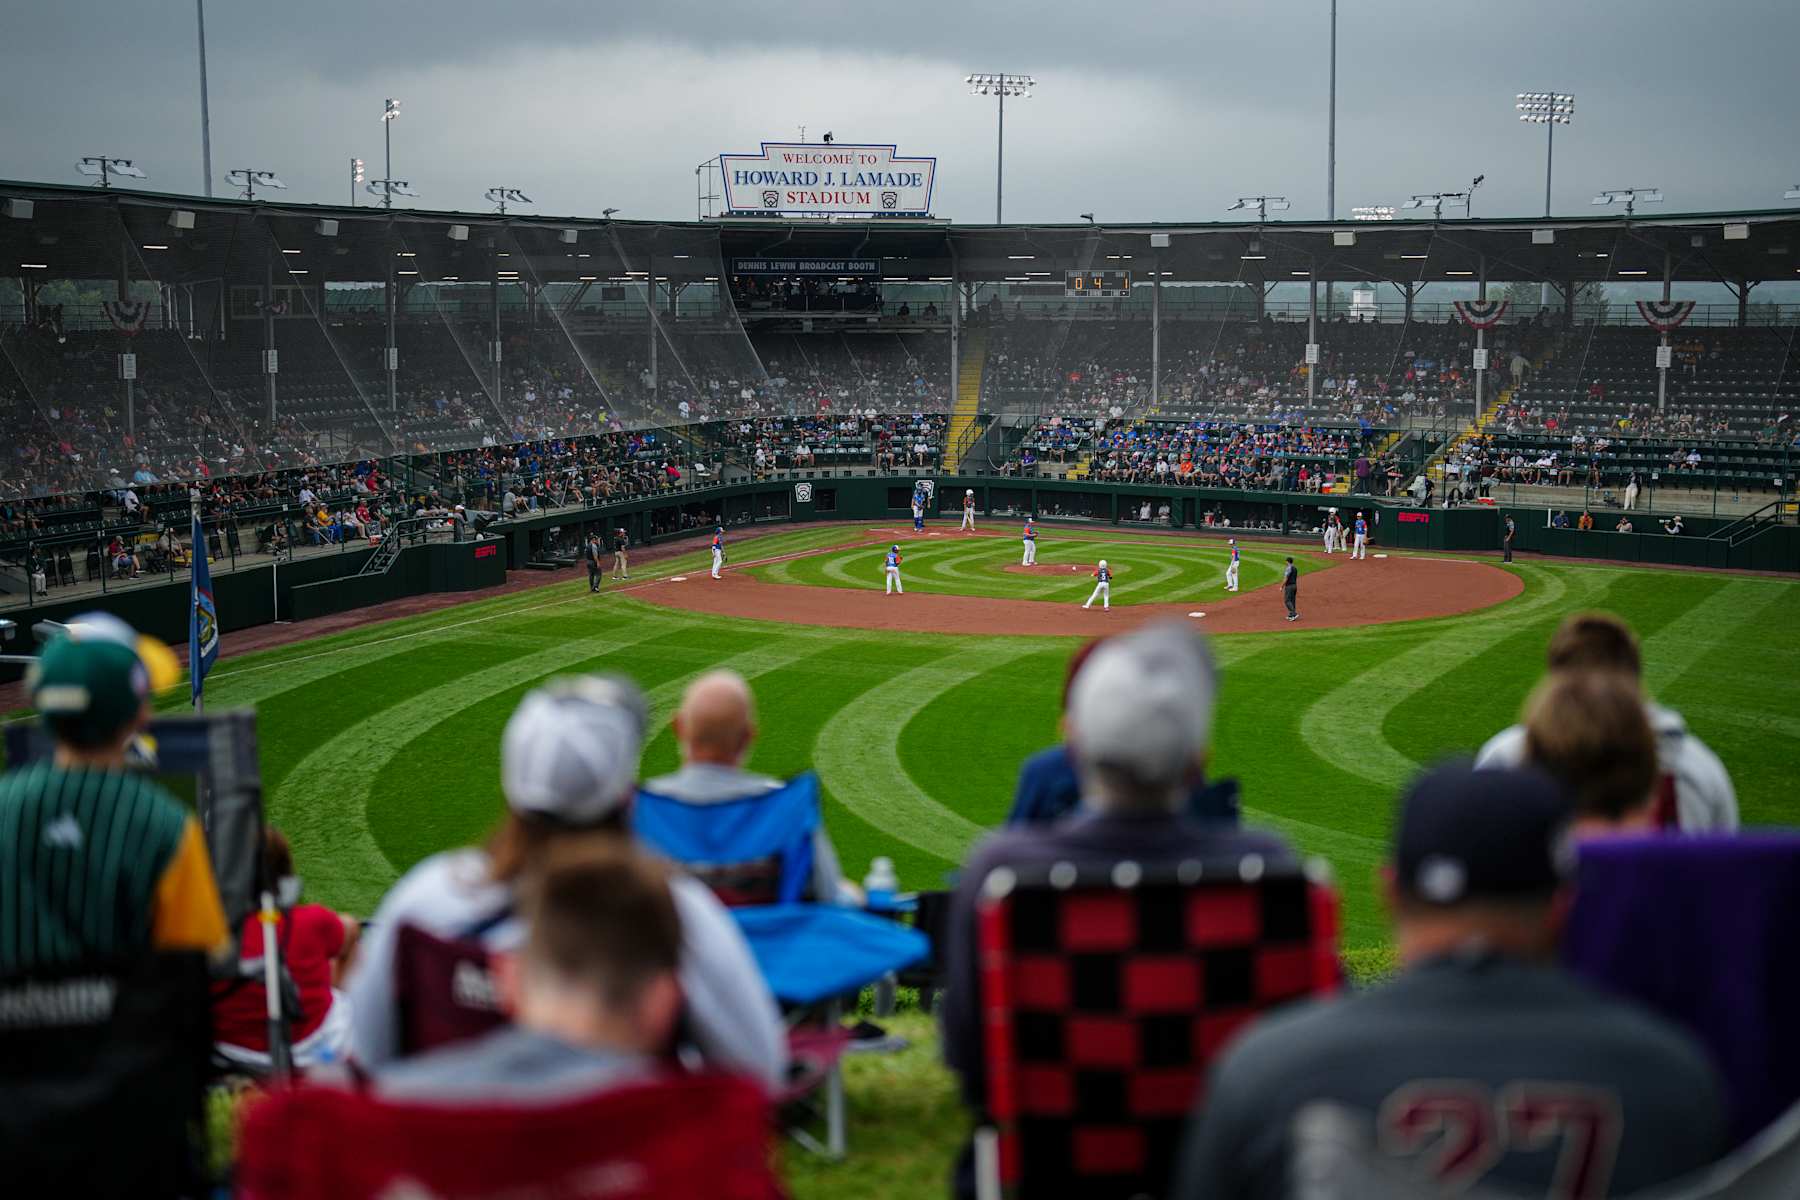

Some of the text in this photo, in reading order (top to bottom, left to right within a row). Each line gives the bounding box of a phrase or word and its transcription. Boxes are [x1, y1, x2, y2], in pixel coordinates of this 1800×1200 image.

[783, 153, 877, 165] WELCOME TO
[734, 171, 922, 188] HOWARD J. LAMADE
[786, 191, 871, 204] STADIUM
[738, 261, 876, 270] DENNIS LEWIN BROADCAST BOOTH
[1076, 278, 1082, 289] 0
[1094, 278, 1102, 289] 4
[1398, 512, 1430, 524] ESPN
[1375, 1077, 1624, 1200] 27
